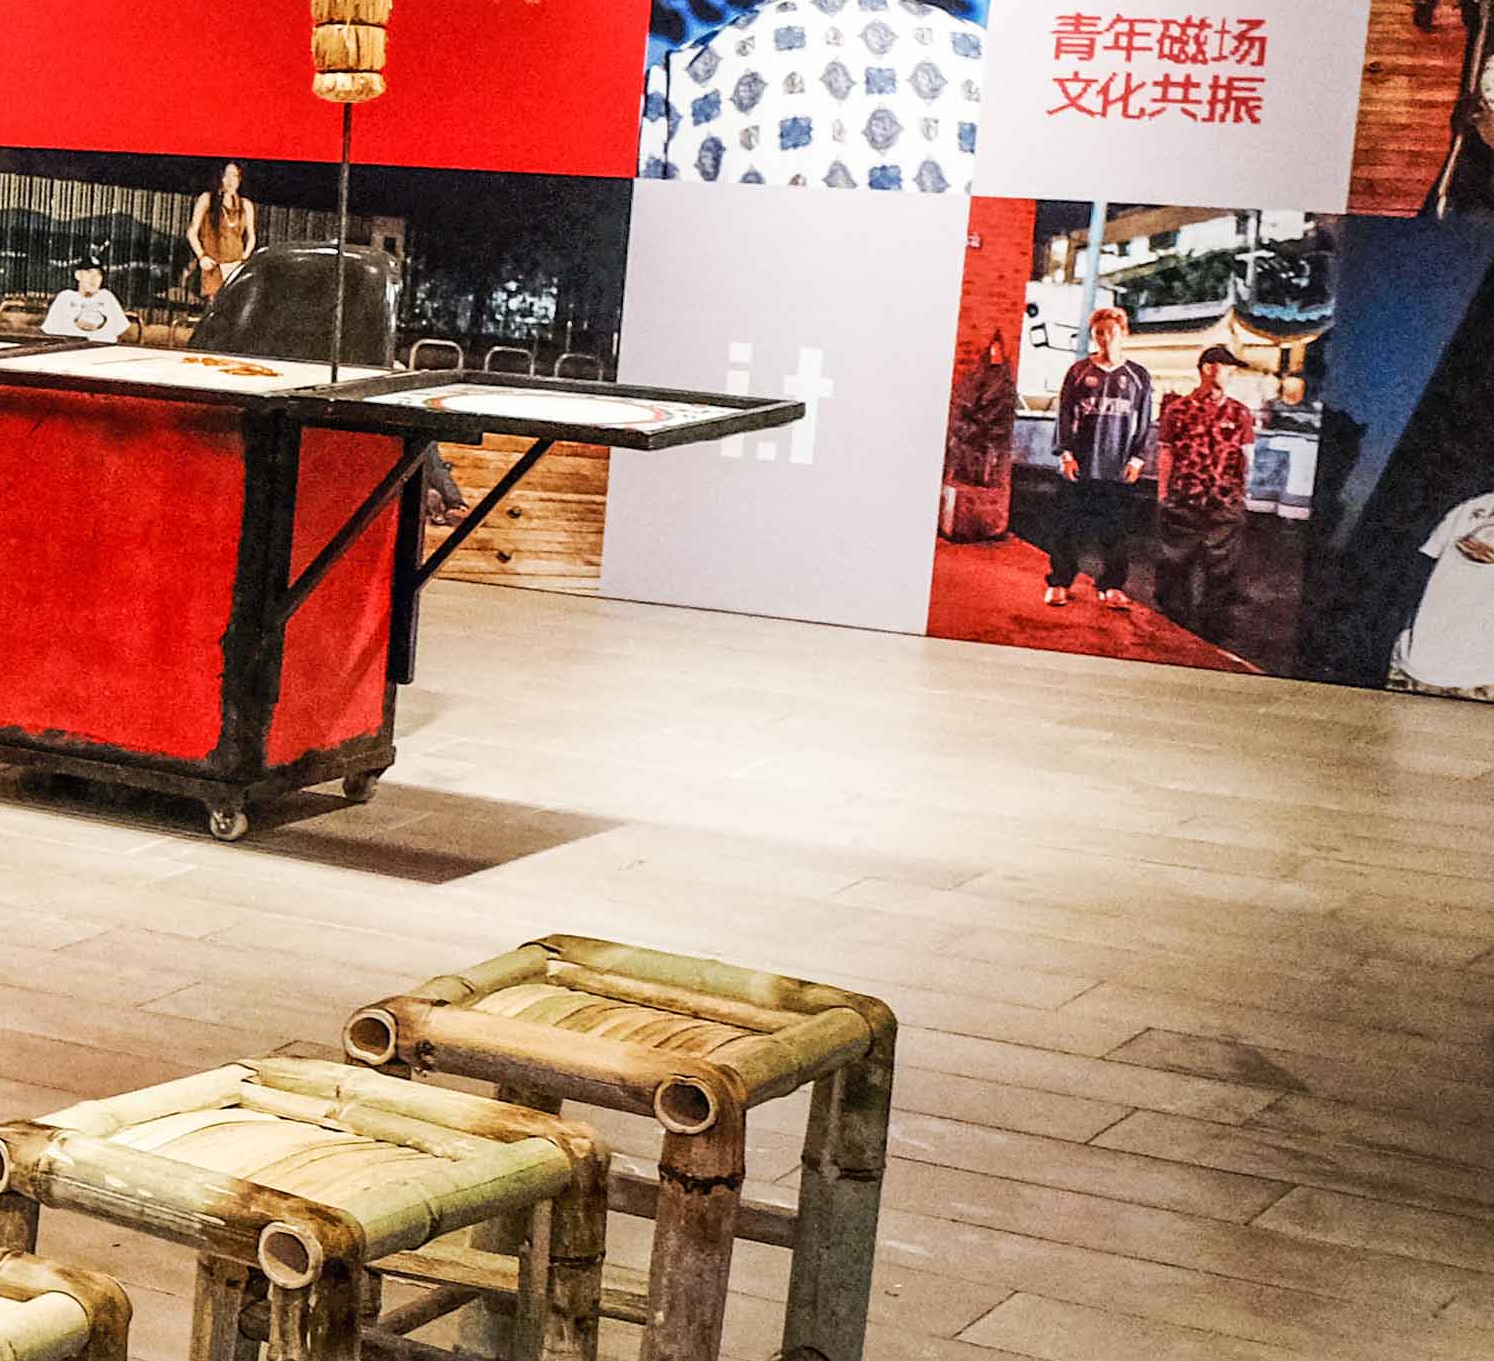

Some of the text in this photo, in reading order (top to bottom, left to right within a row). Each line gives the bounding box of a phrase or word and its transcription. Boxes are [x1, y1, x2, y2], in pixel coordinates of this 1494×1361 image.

[1051, 14, 1266, 66] 青年磁场
[1046, 72, 1264, 126] 文化共振
[720, 342, 834, 465] i.t
